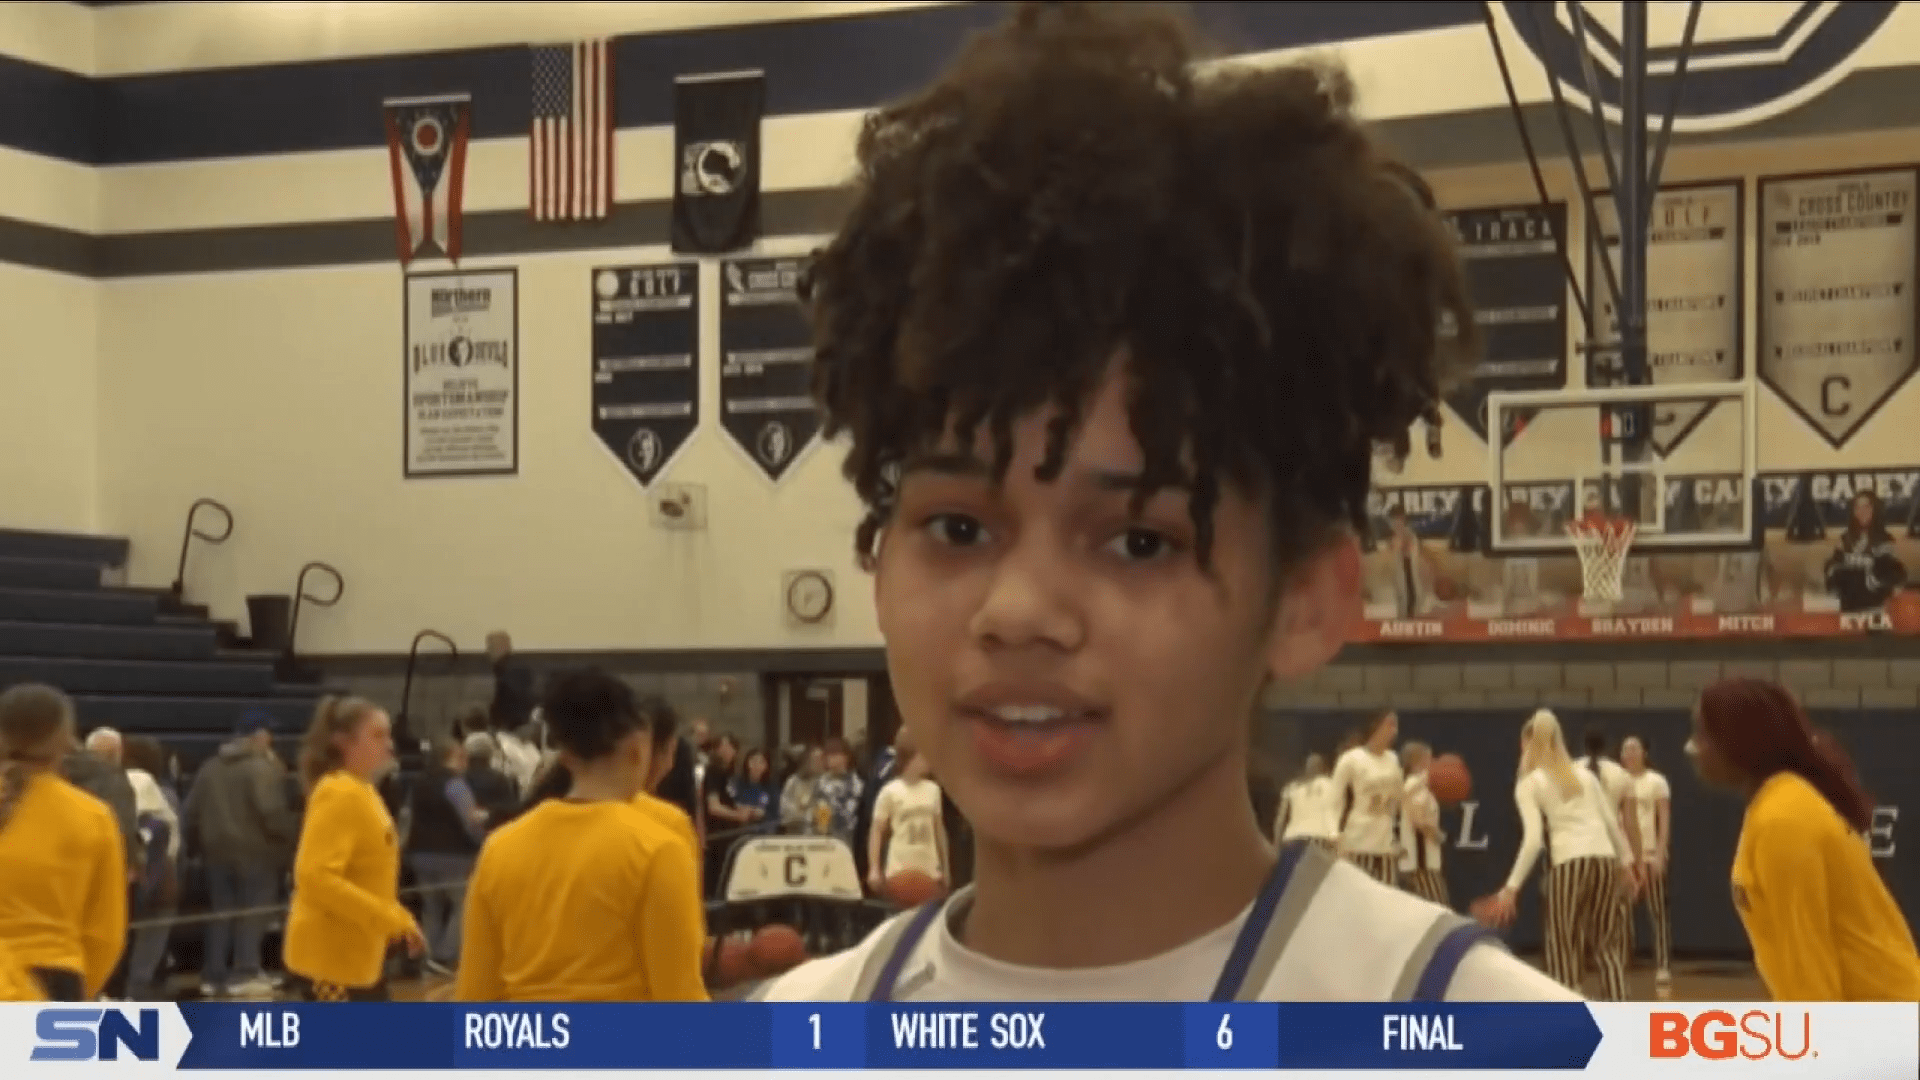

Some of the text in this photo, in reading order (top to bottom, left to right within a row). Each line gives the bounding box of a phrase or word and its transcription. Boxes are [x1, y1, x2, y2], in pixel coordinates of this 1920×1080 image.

[1821, 376, 1851, 417] C
[1487, 618, 1556, 637] DOMINIC
[1717, 614, 1775, 633] MITCH
[784, 855, 808, 887] C
